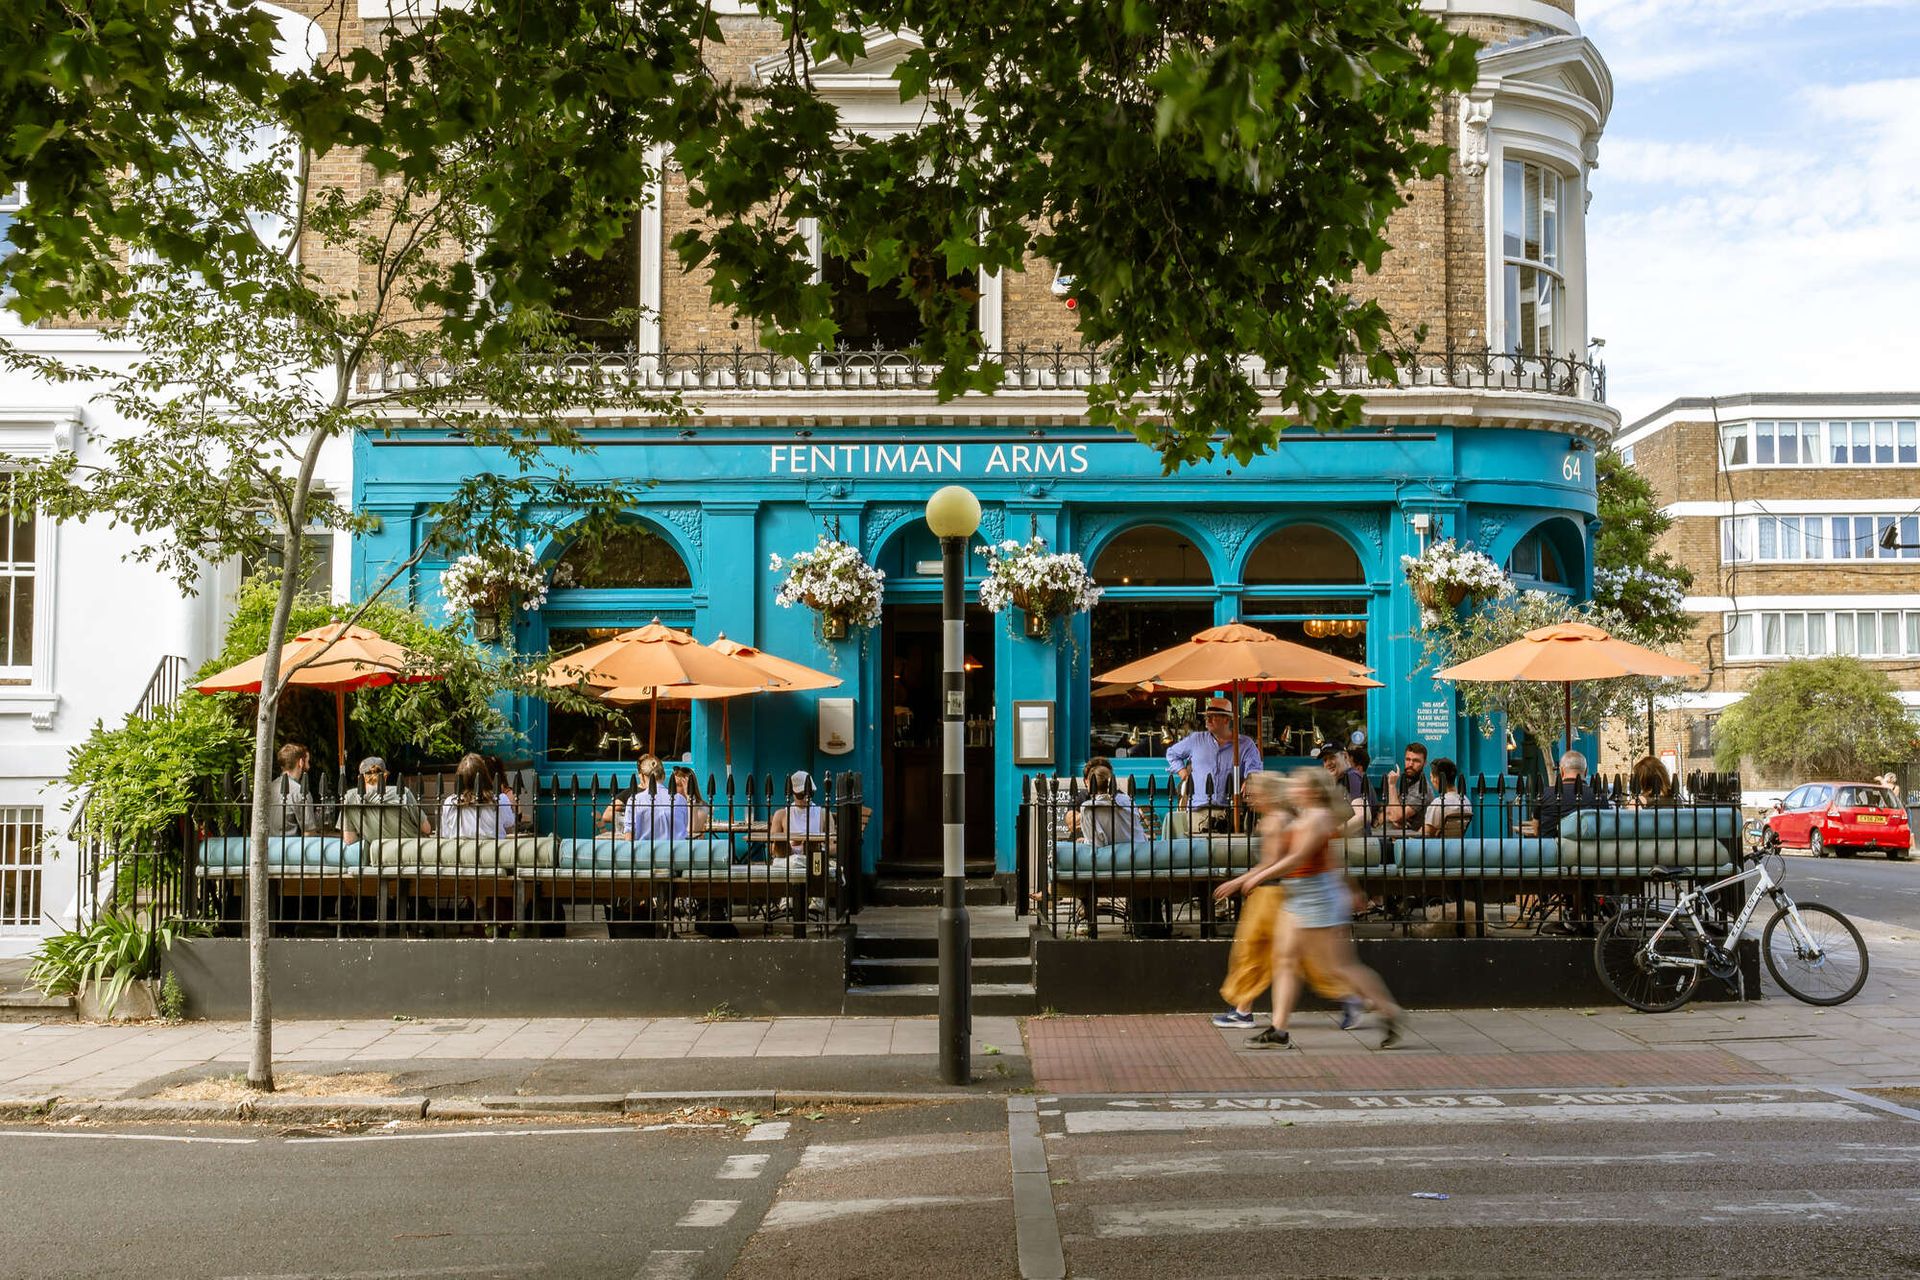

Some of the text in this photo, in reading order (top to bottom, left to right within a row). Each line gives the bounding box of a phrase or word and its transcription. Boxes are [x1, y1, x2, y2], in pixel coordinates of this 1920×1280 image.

[770, 445, 1088, 473] FENTIMAN ARMS
[1562, 455, 1581, 482] 64
[1168, 1093, 1688, 1110] LOOK BOTH WAYS
